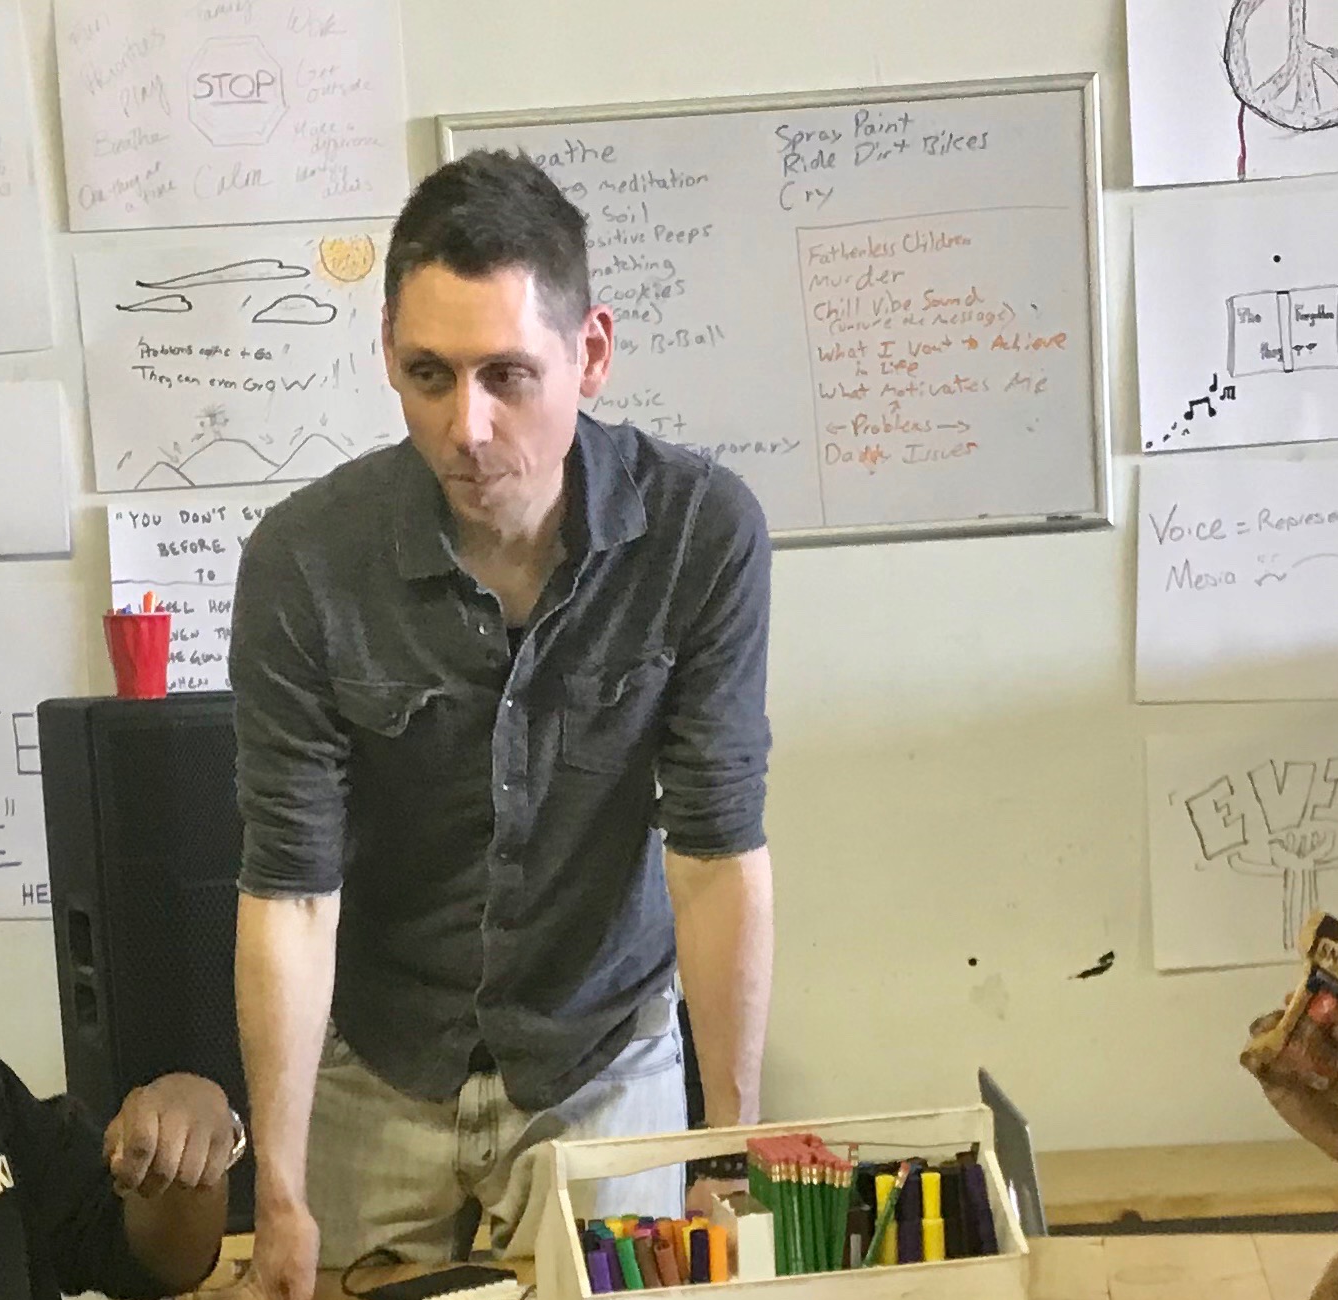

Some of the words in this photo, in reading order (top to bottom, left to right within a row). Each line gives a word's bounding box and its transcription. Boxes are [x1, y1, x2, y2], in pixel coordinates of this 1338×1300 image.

[192, 69, 275, 100] STOP
[774, 123, 843, 153] Spray
[853, 108, 914, 137] Paint
[781, 150, 836, 178] Ride
[853, 140, 910, 167] Dirt
[922, 130, 990, 156] Bikes
[598, 168, 709, 194] meditation
[779, 180, 834, 211] Cry
[601, 201, 649, 224] Soil
[585, 228, 646, 250] ositive
[653, 223, 714, 245] Peeps
[591, 254, 677, 281] natching
[179, 505, 227, 525] DON'T
[1149, 503, 1227, 545] Voice
[156, 537, 226, 558] BEFORE
[170, 627, 200, 642] VEN
